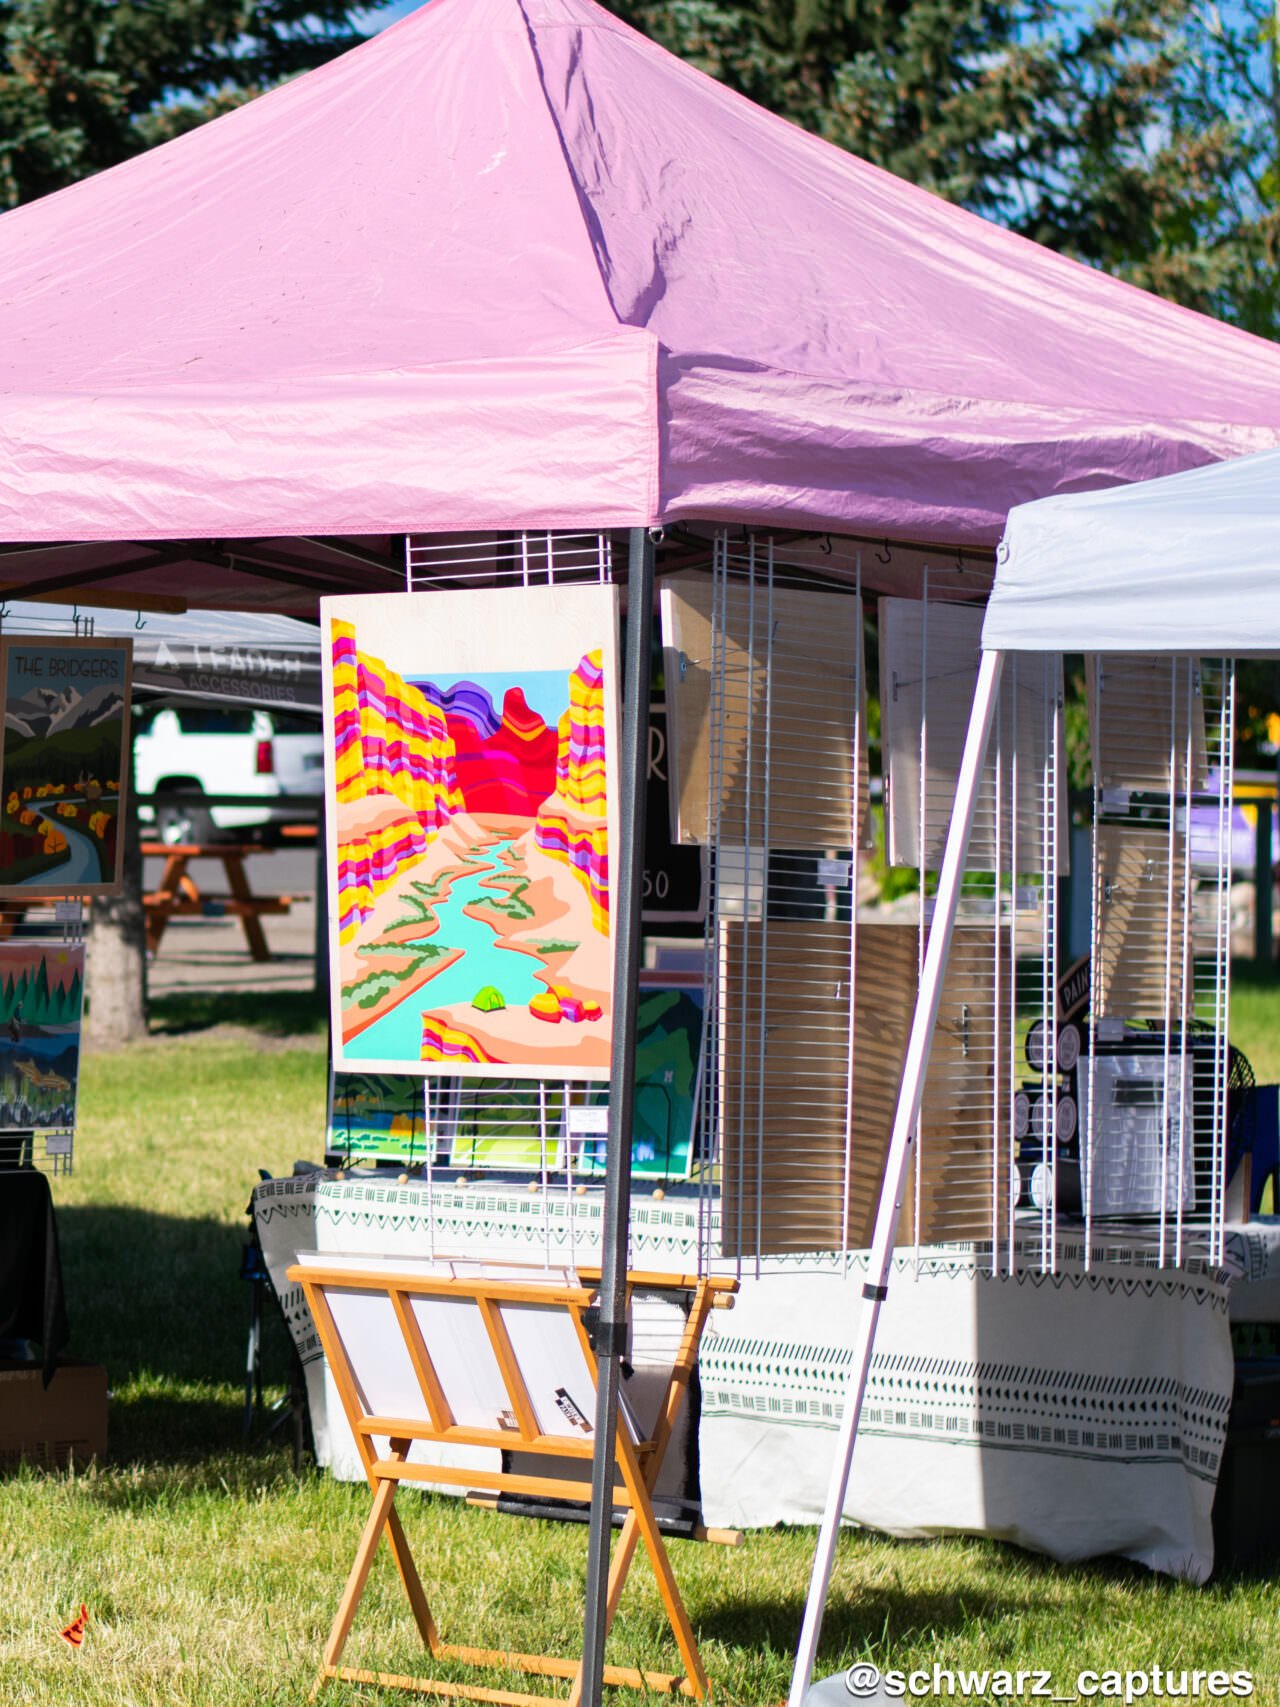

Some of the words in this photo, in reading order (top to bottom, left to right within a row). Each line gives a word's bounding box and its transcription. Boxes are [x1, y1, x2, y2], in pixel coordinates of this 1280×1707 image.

[15, 656, 44, 677] THE
[48, 657, 119, 679] BRIDGERS
[193, 643, 301, 681] LEADER
[188, 673, 296, 703] ACCESSORIES
